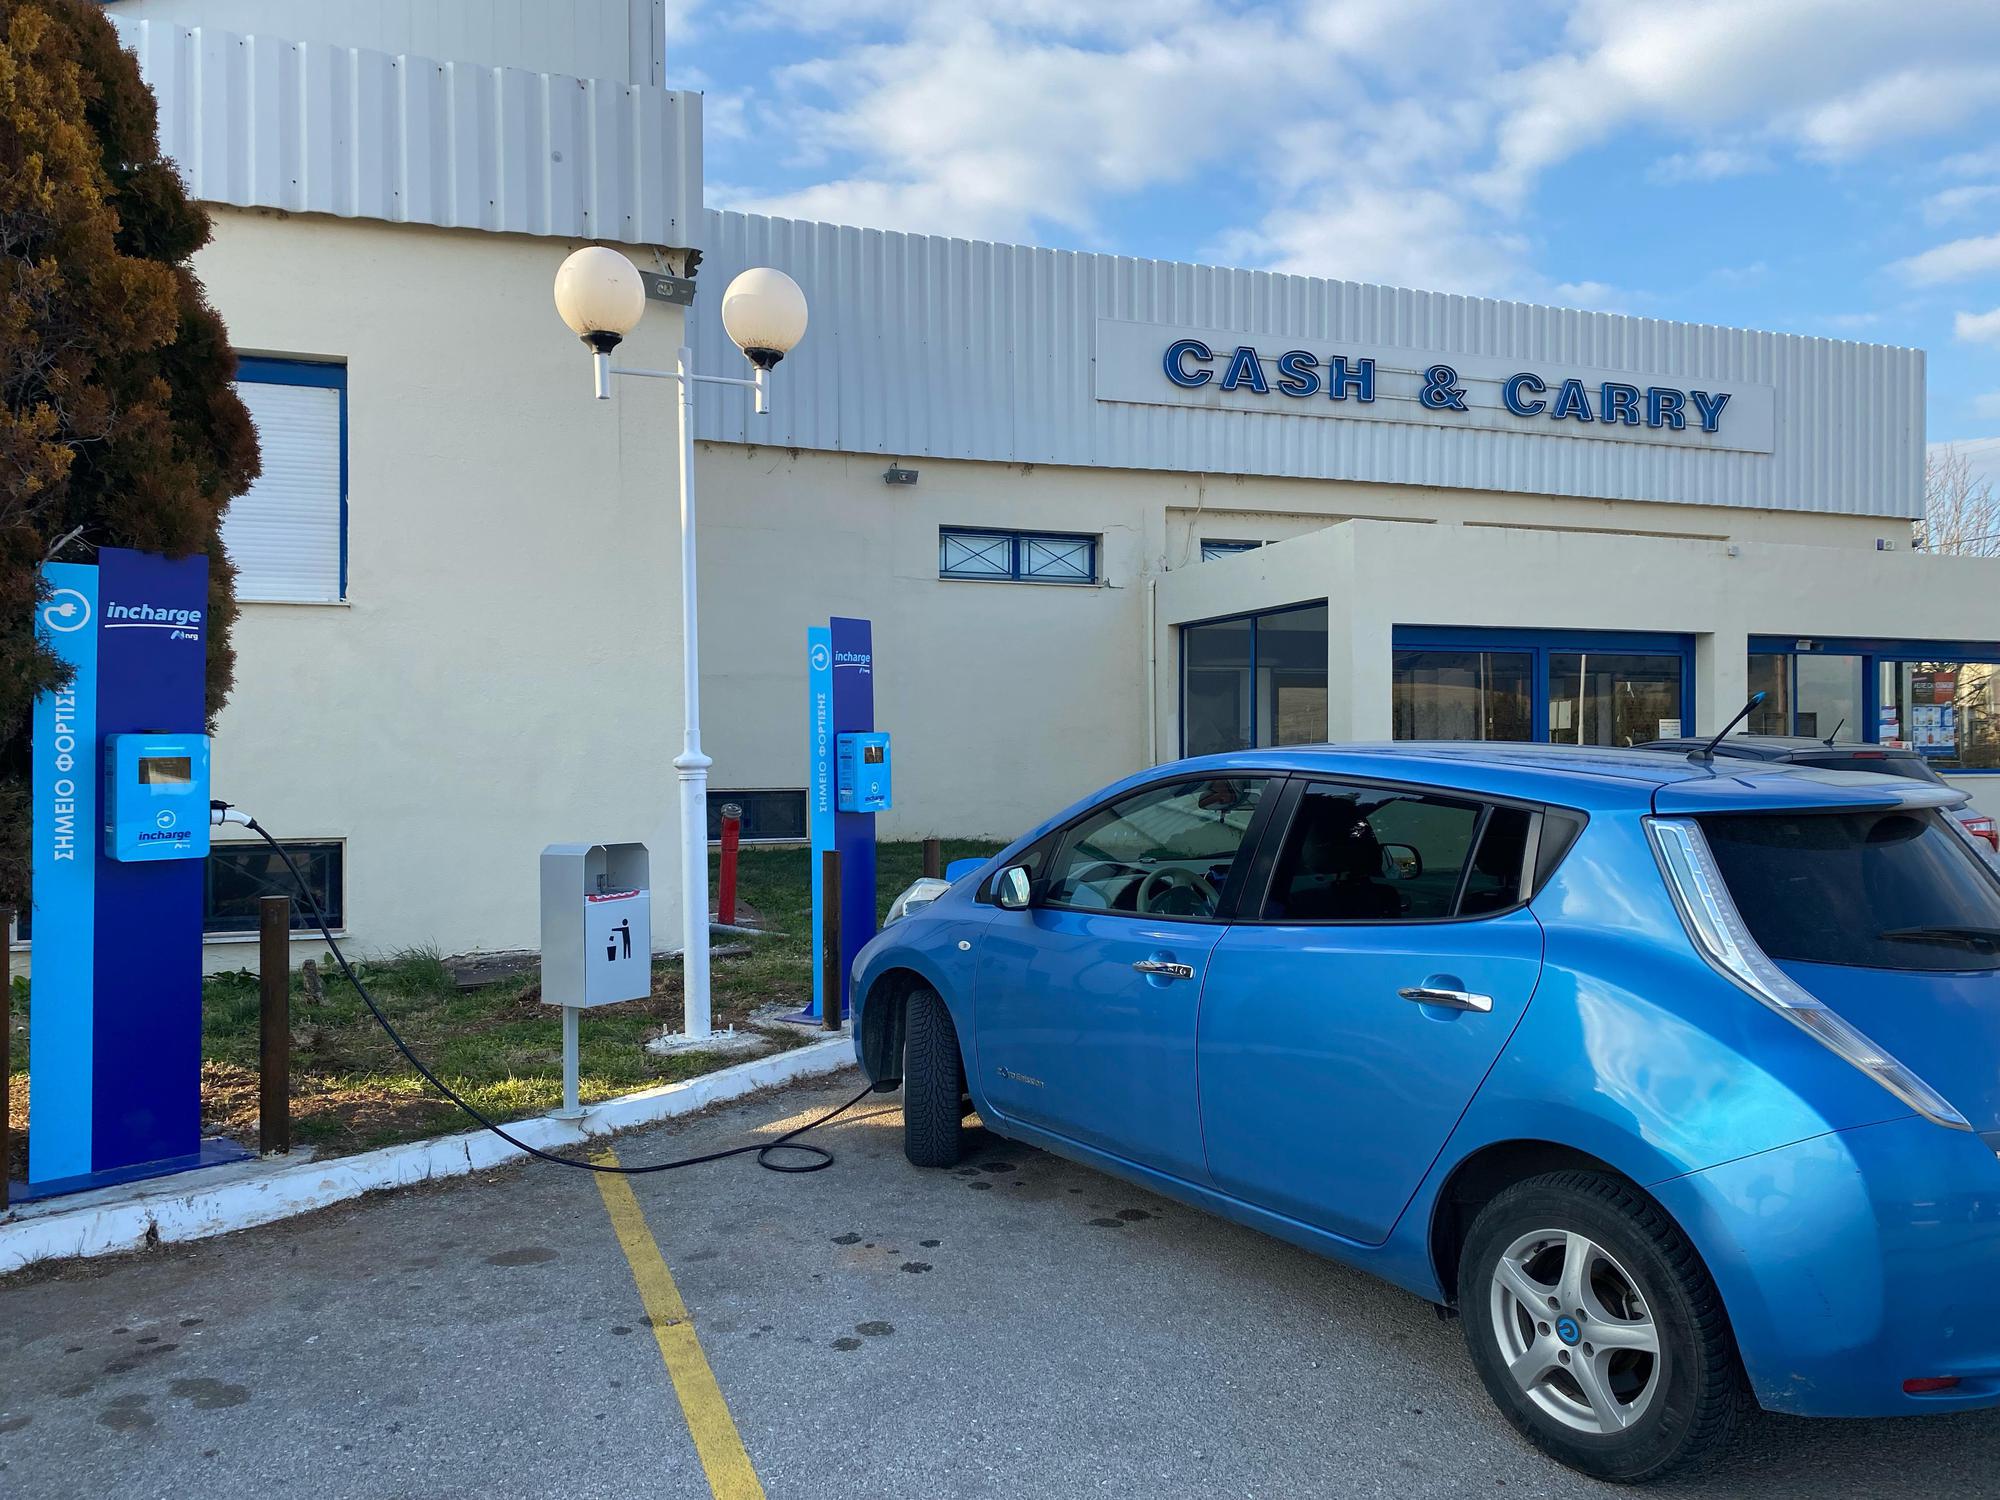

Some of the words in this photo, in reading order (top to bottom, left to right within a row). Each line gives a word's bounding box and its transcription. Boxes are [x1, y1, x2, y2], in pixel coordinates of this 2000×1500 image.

[1163, 339, 1376, 403] CASH
[1419, 364, 1469, 411] &
[1502, 372, 1732, 432] CARRY
[107, 602, 201, 625] incharge
[835, 651, 870, 664] incharge
[818, 693, 826, 757] ΦΟΡΤΙΣΗΣ
[819, 761, 828, 812] ΣΗΜΕΙΟ
[55, 778, 75, 861] ΣΗΜΕΙΟ
[138, 831, 191, 841] incharge
